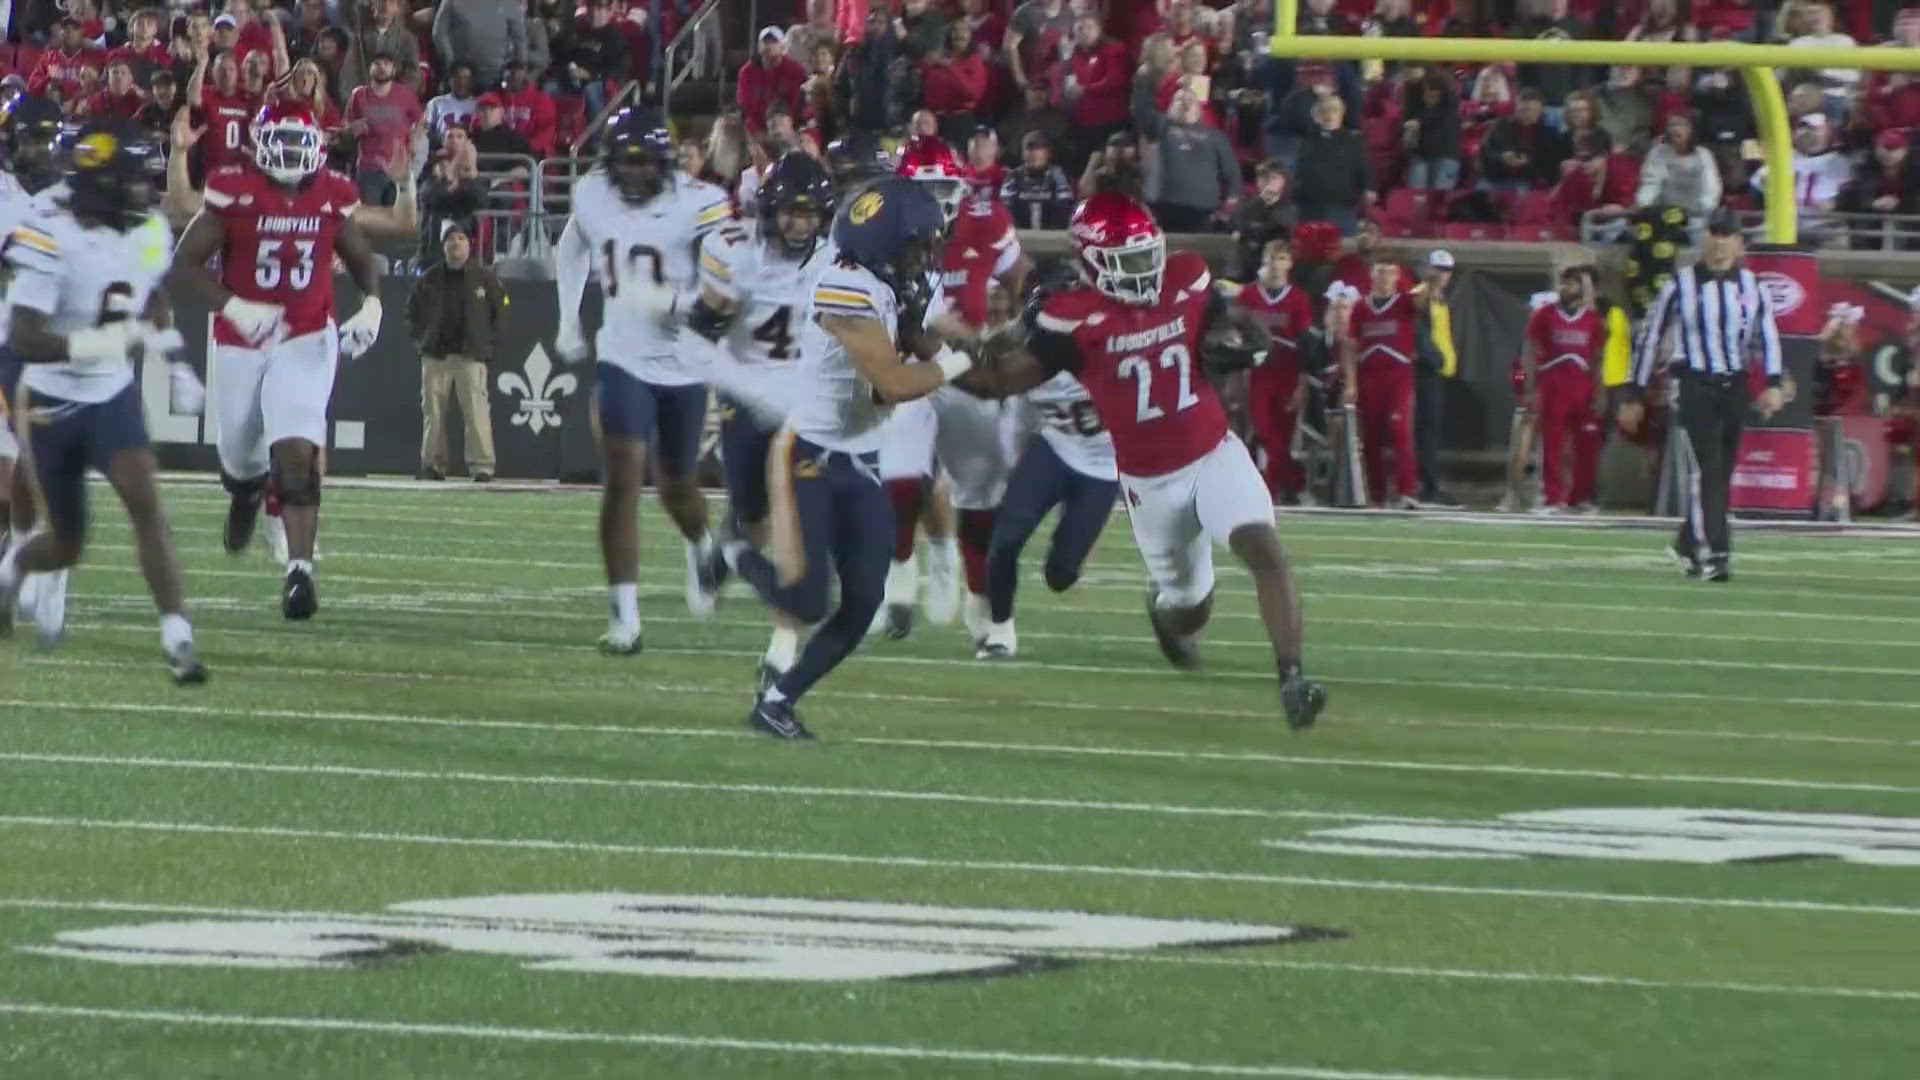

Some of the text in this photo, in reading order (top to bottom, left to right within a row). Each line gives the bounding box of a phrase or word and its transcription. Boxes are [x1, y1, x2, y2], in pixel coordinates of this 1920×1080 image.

[257, 215, 321, 233] LOUISVILLE
[255, 240, 316, 290] 53
[1106, 315, 1186, 353] LOUISVILLE
[1117, 344, 1200, 423] 22
